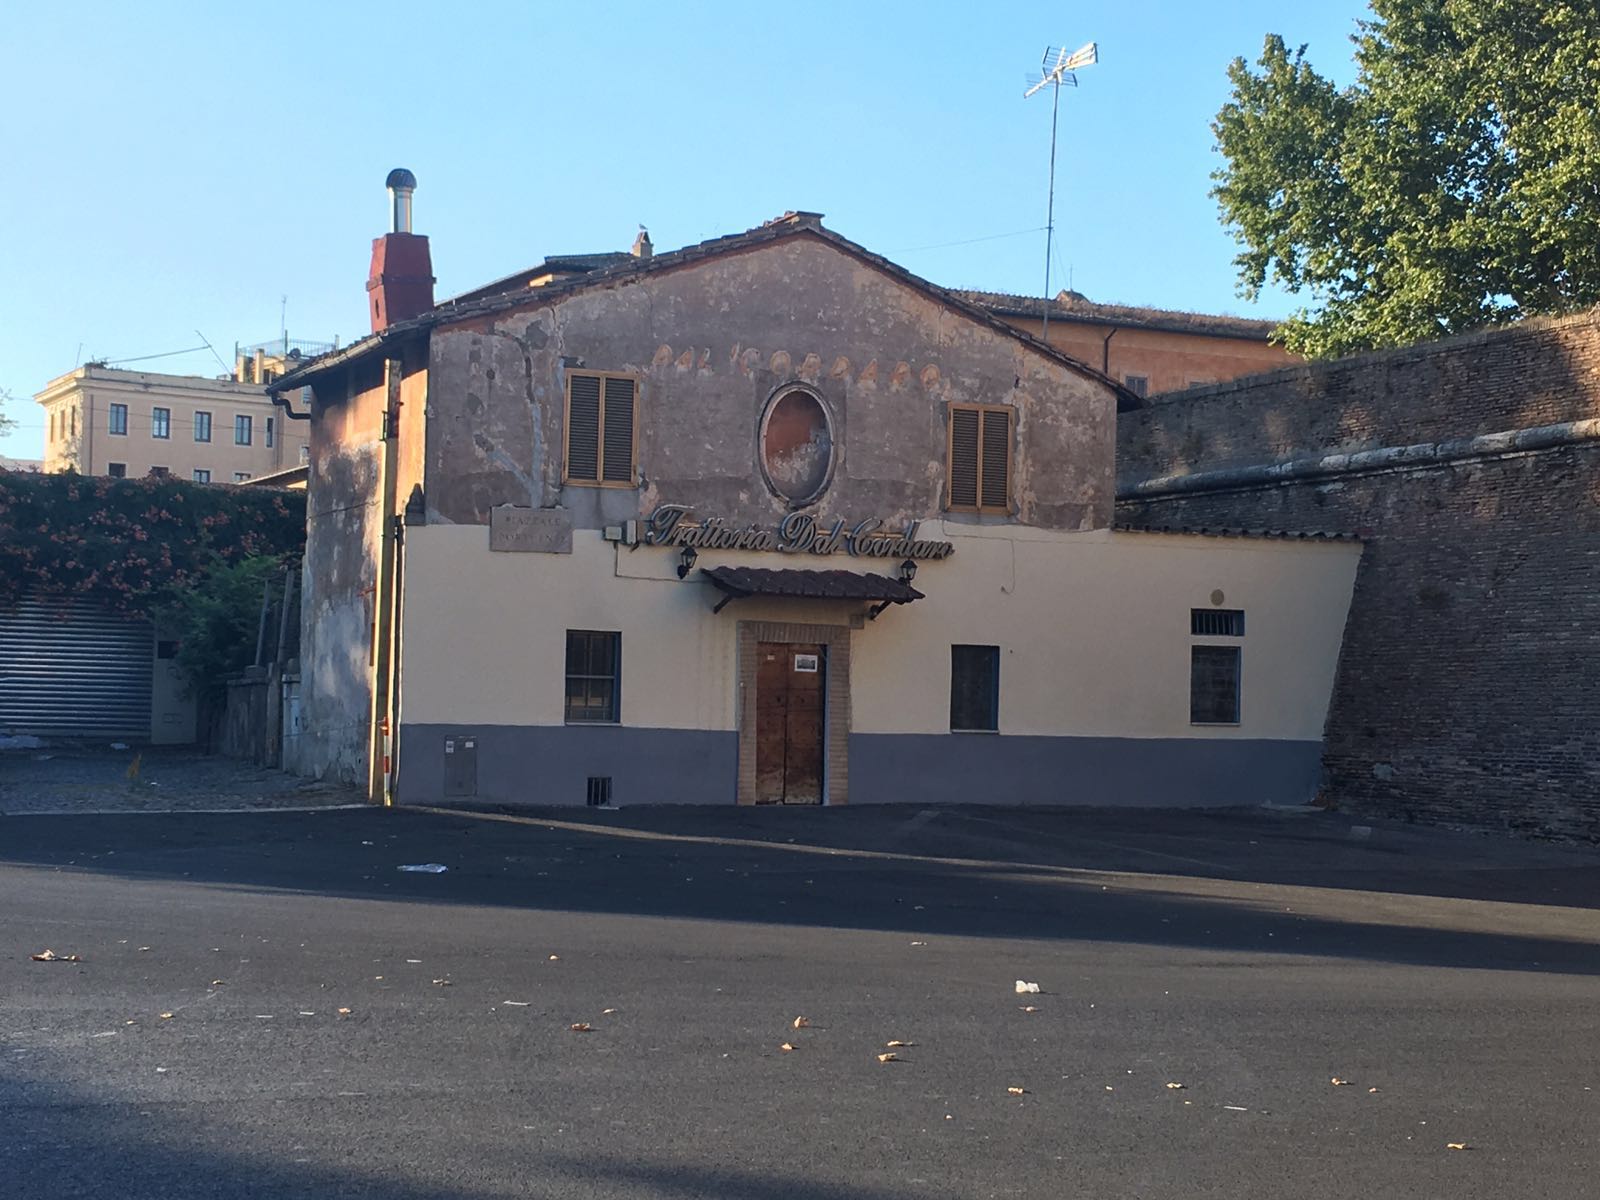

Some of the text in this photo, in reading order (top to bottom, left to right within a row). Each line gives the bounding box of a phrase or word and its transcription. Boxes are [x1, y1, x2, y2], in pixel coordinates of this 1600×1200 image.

[645, 503, 956, 561] Trattoria Dal Cordaro
